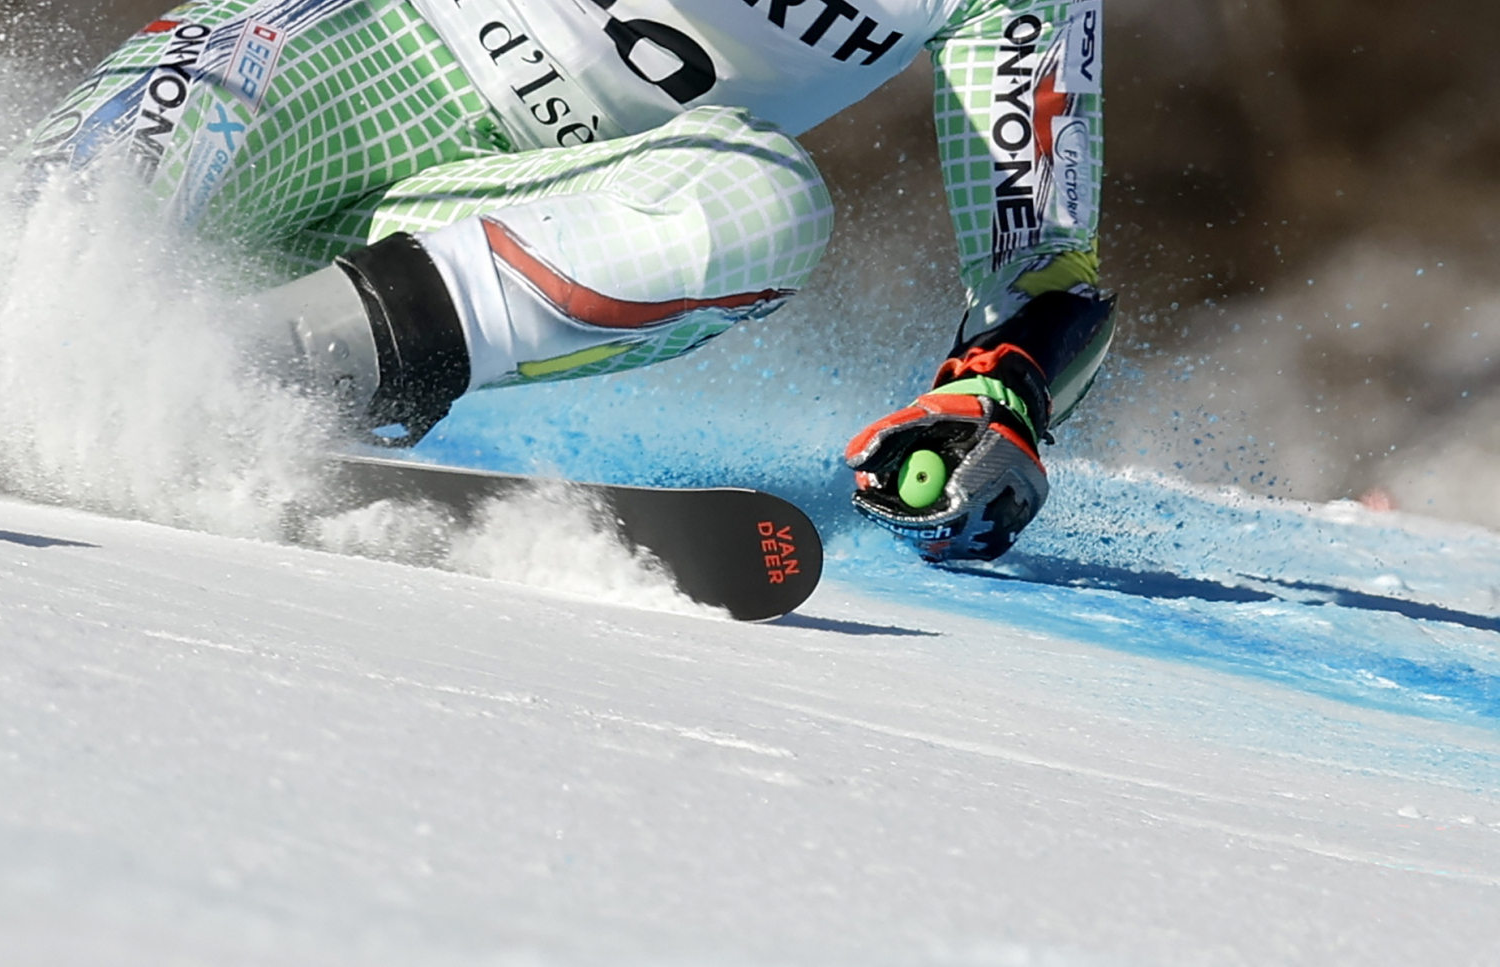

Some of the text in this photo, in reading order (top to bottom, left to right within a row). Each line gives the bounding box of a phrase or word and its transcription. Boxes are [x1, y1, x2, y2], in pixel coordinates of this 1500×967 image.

[1081, 9, 1097, 83] DSV
[992, 13, 1041, 233] ONYONE
[757, 521, 785, 584] DEER
[776, 525, 801, 575] VAN
